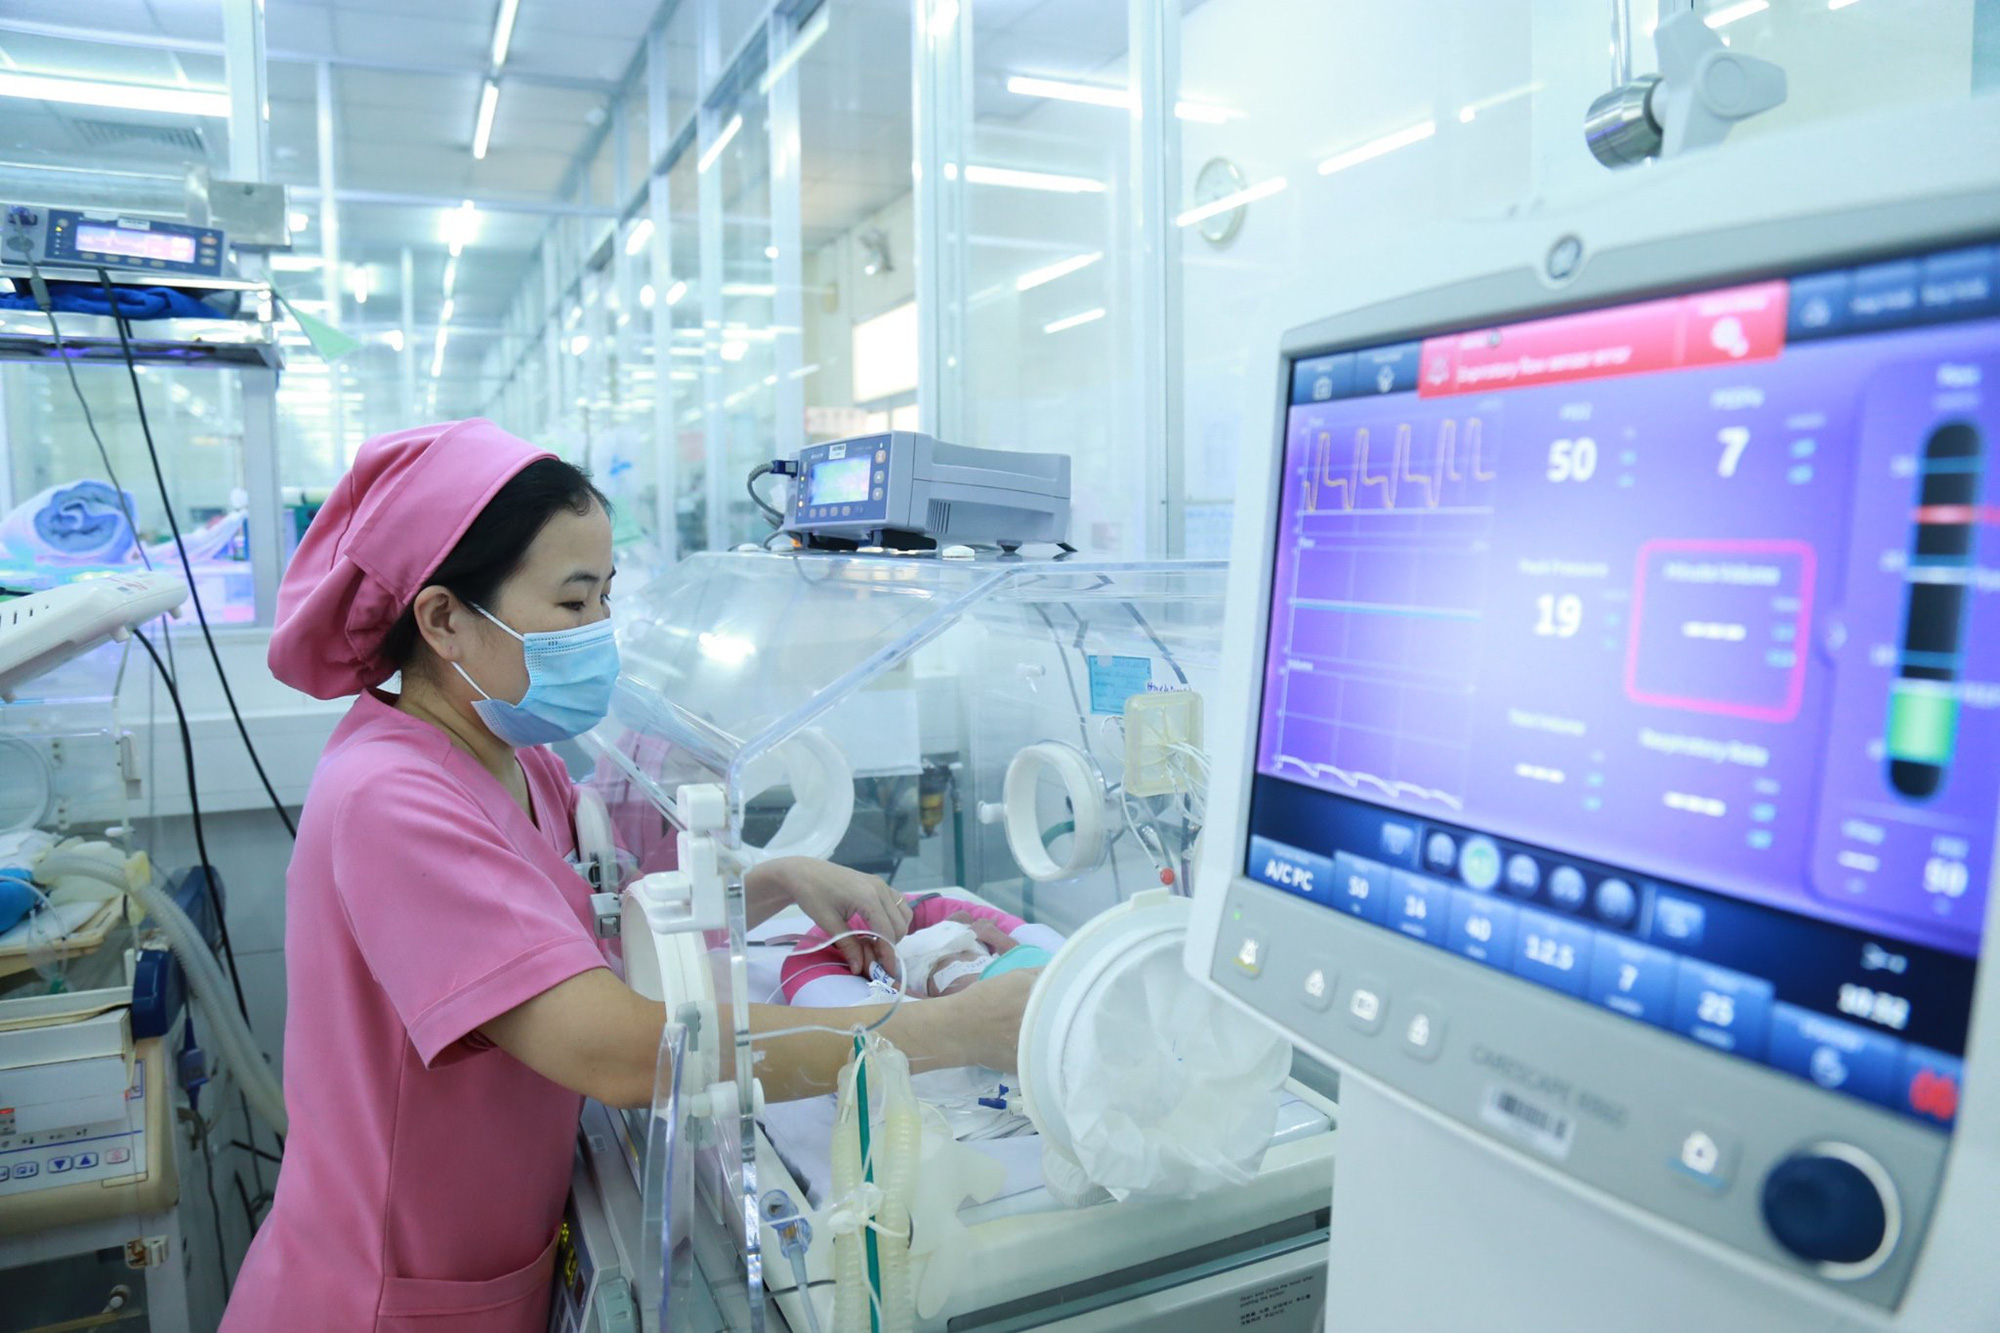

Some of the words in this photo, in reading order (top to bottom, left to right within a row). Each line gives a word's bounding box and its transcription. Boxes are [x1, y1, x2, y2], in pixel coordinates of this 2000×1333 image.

[1548, 437, 1597, 482] 50
[1717, 426, 1750, 478] 7
[1533, 593, 1582, 638] 19
